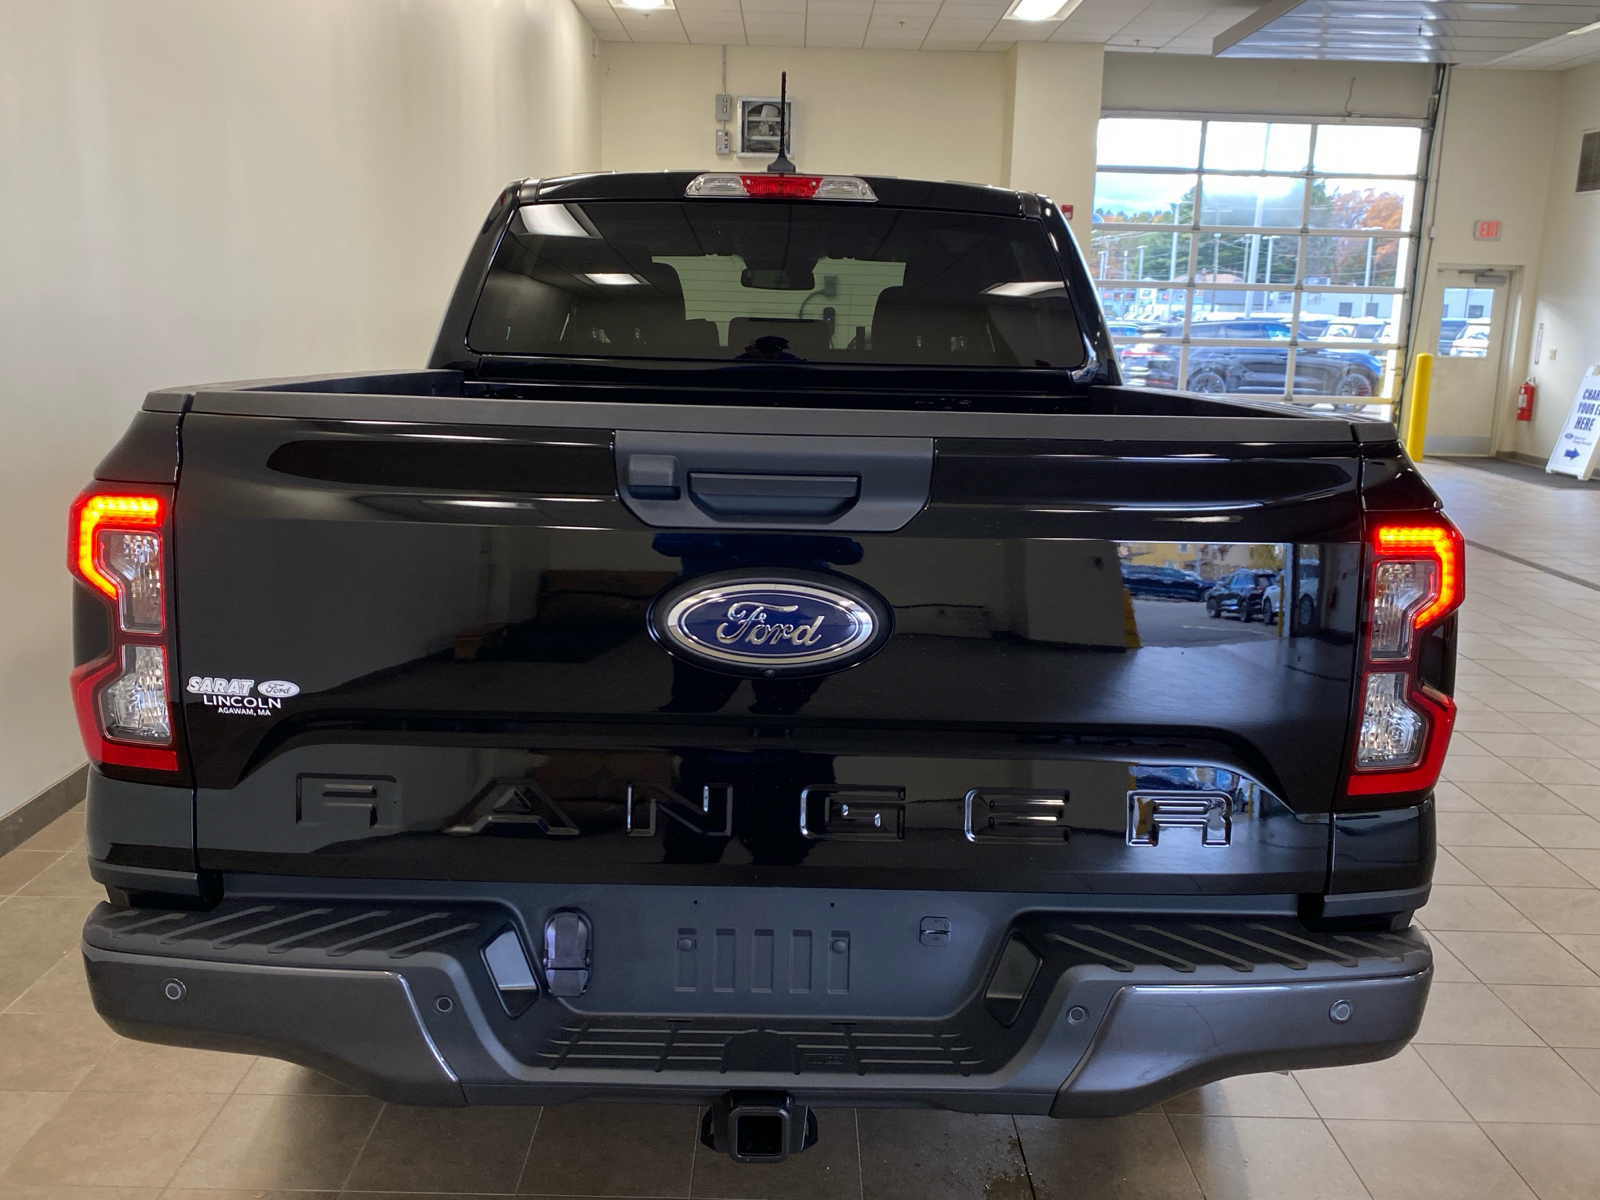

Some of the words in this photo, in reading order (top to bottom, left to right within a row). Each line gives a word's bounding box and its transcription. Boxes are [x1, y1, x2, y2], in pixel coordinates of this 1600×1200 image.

[1479, 221, 1500, 237] EXIT
[1577, 402, 1596, 415] YOUR
[1574, 416, 1596, 431] HERE
[716, 601, 823, 646] Ford
[187, 676, 254, 696] SARAT
[203, 694, 282, 709] LINCOLN
[218, 707, 257, 717] AGAWAM,
[258, 708, 272, 717] MA
[296, 772, 1233, 847] RANGER
